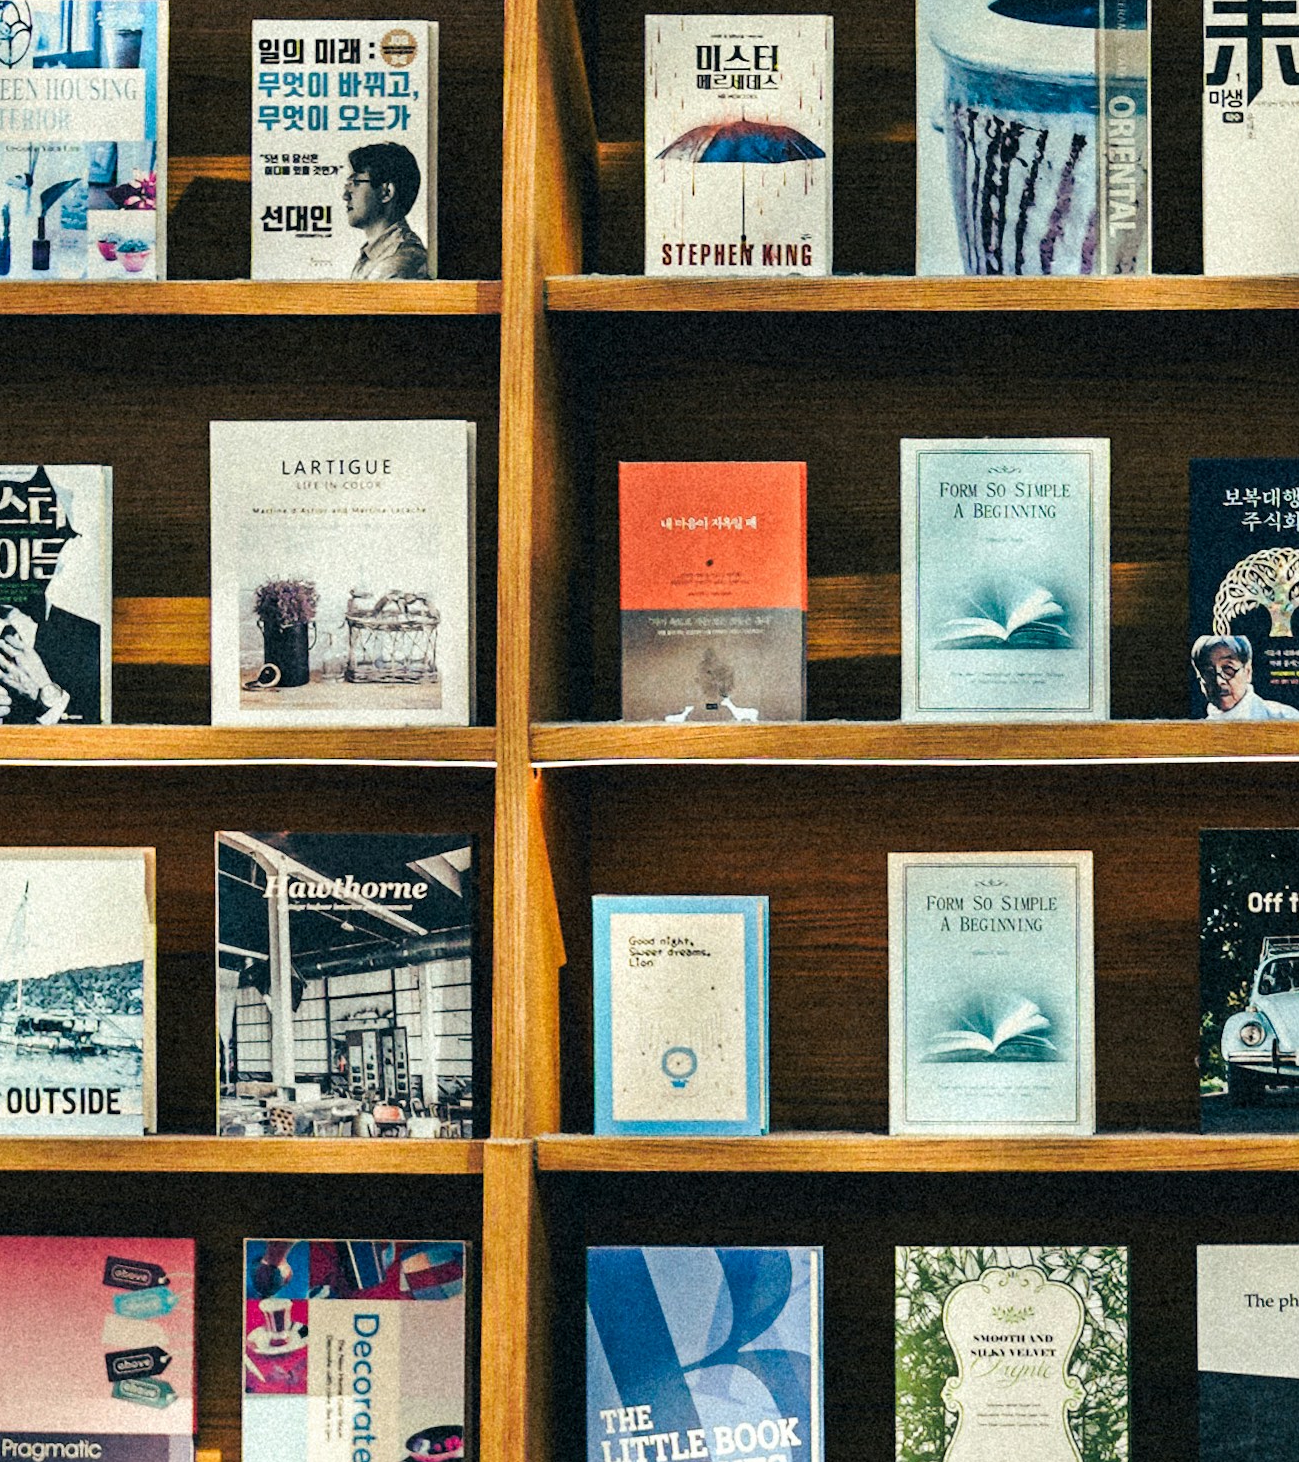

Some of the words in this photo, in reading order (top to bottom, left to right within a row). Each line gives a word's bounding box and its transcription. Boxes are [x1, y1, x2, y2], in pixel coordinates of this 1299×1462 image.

[696, 45, 778, 72] 미스터
[696, 74, 779, 91] 메르세데스
[1109, 95, 1138, 240] ORIENTAL
[662, 244, 754, 267] STEPHEN
[762, 243, 812, 266] KING
[263, 875, 428, 902] Hawthorne
[1248, 892, 1283, 913] Off
[7, 1086, 121, 1115] OUTSIDE
[1244, 1293, 1274, 1308] The
[600, 1406, 653, 1435] THE
[715, 1416, 801, 1454] BOOK
[2, 1439, 102, 1462] Pragmatic
